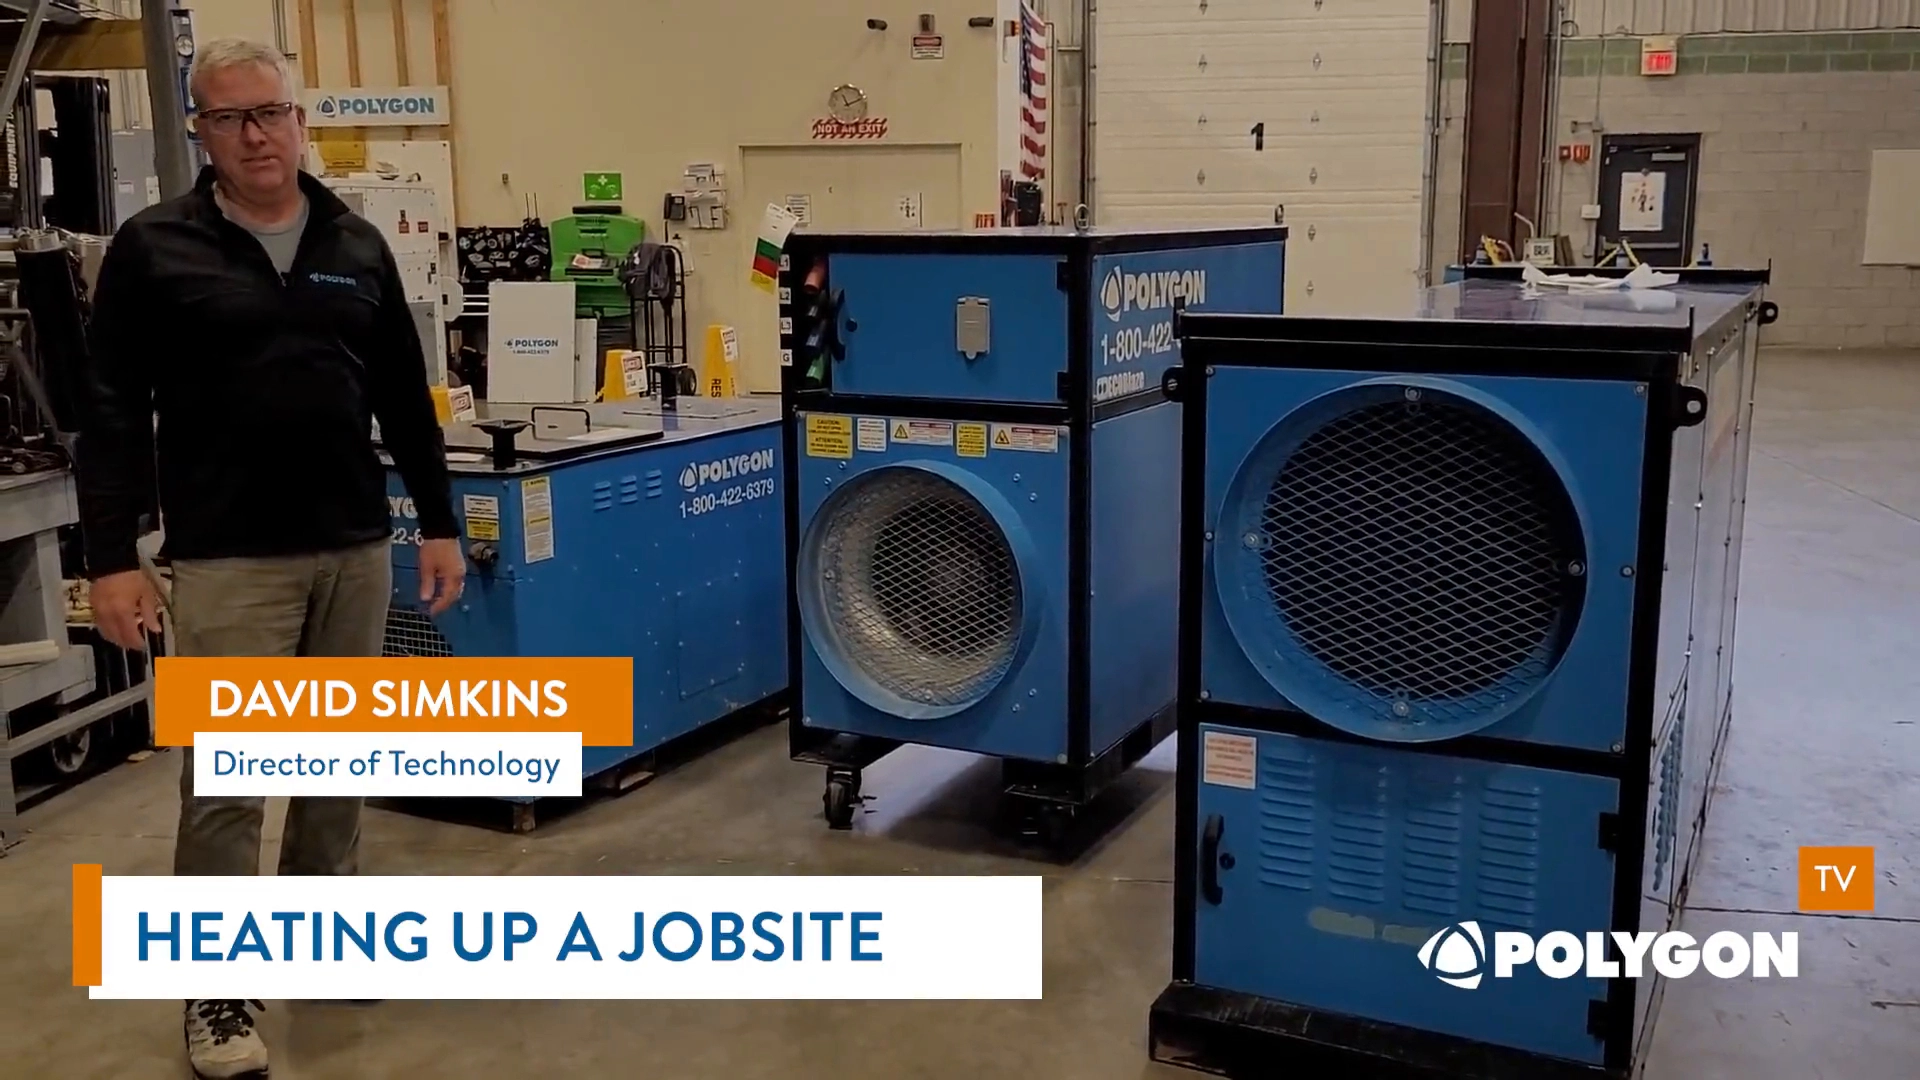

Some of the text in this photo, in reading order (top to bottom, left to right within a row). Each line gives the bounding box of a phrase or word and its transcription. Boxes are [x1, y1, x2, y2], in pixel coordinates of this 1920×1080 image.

[339, 98, 434, 114] POLYGON
[818, 124, 839, 133] NOT
[859, 124, 882, 133] EXIT
[1251, 122, 1264, 151] 1
[6, 121, 18, 188] EQUIPMENT
[780, 290, 790, 301] L2
[1123, 270, 1206, 312] POLYGON
[515, 339, 559, 347] POLYGON
[699, 448, 774, 486] POLYGON
[679, 478, 775, 518] 1-800-422-6379
